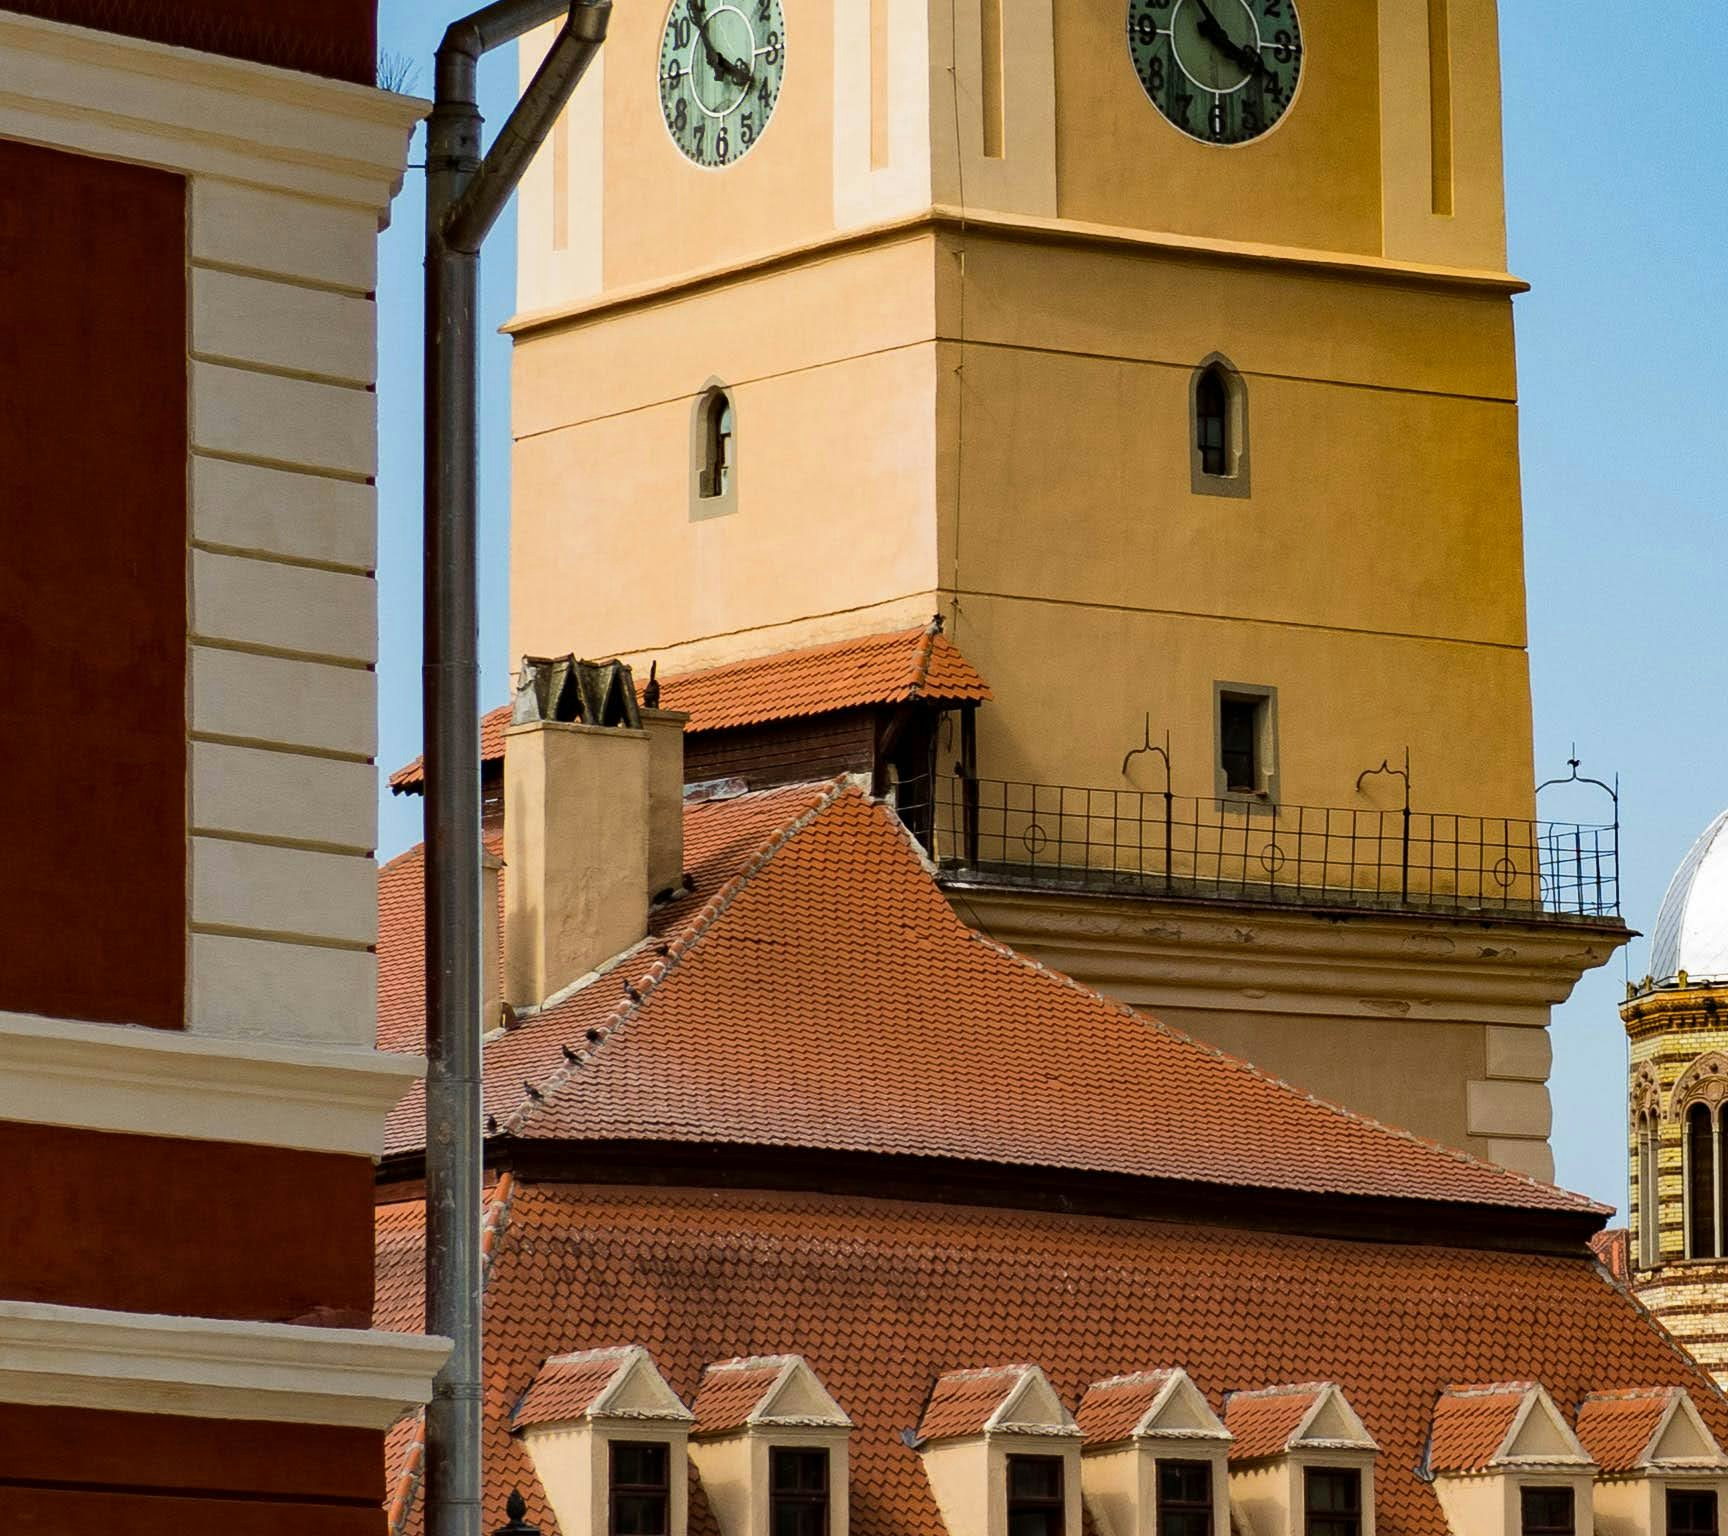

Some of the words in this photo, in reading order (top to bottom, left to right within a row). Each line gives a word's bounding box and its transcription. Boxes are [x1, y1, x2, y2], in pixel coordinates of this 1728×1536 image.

[670, 16, 691, 51] 10
[1137, 13, 1156, 46] 9
[1274, 29, 1292, 64] 3
[765, 31, 779, 66] 3
[668, 58, 681, 90] 9
[1149, 56, 1164, 91] 8
[1264, 71, 1283, 103] 4
[758, 75, 771, 108] 4
[674, 97, 687, 132] 8
[740, 111, 753, 145] 5
[1208, 103, 1226, 137] 6
[693, 124, 705, 159] 7
[715, 126, 729, 160] 6
